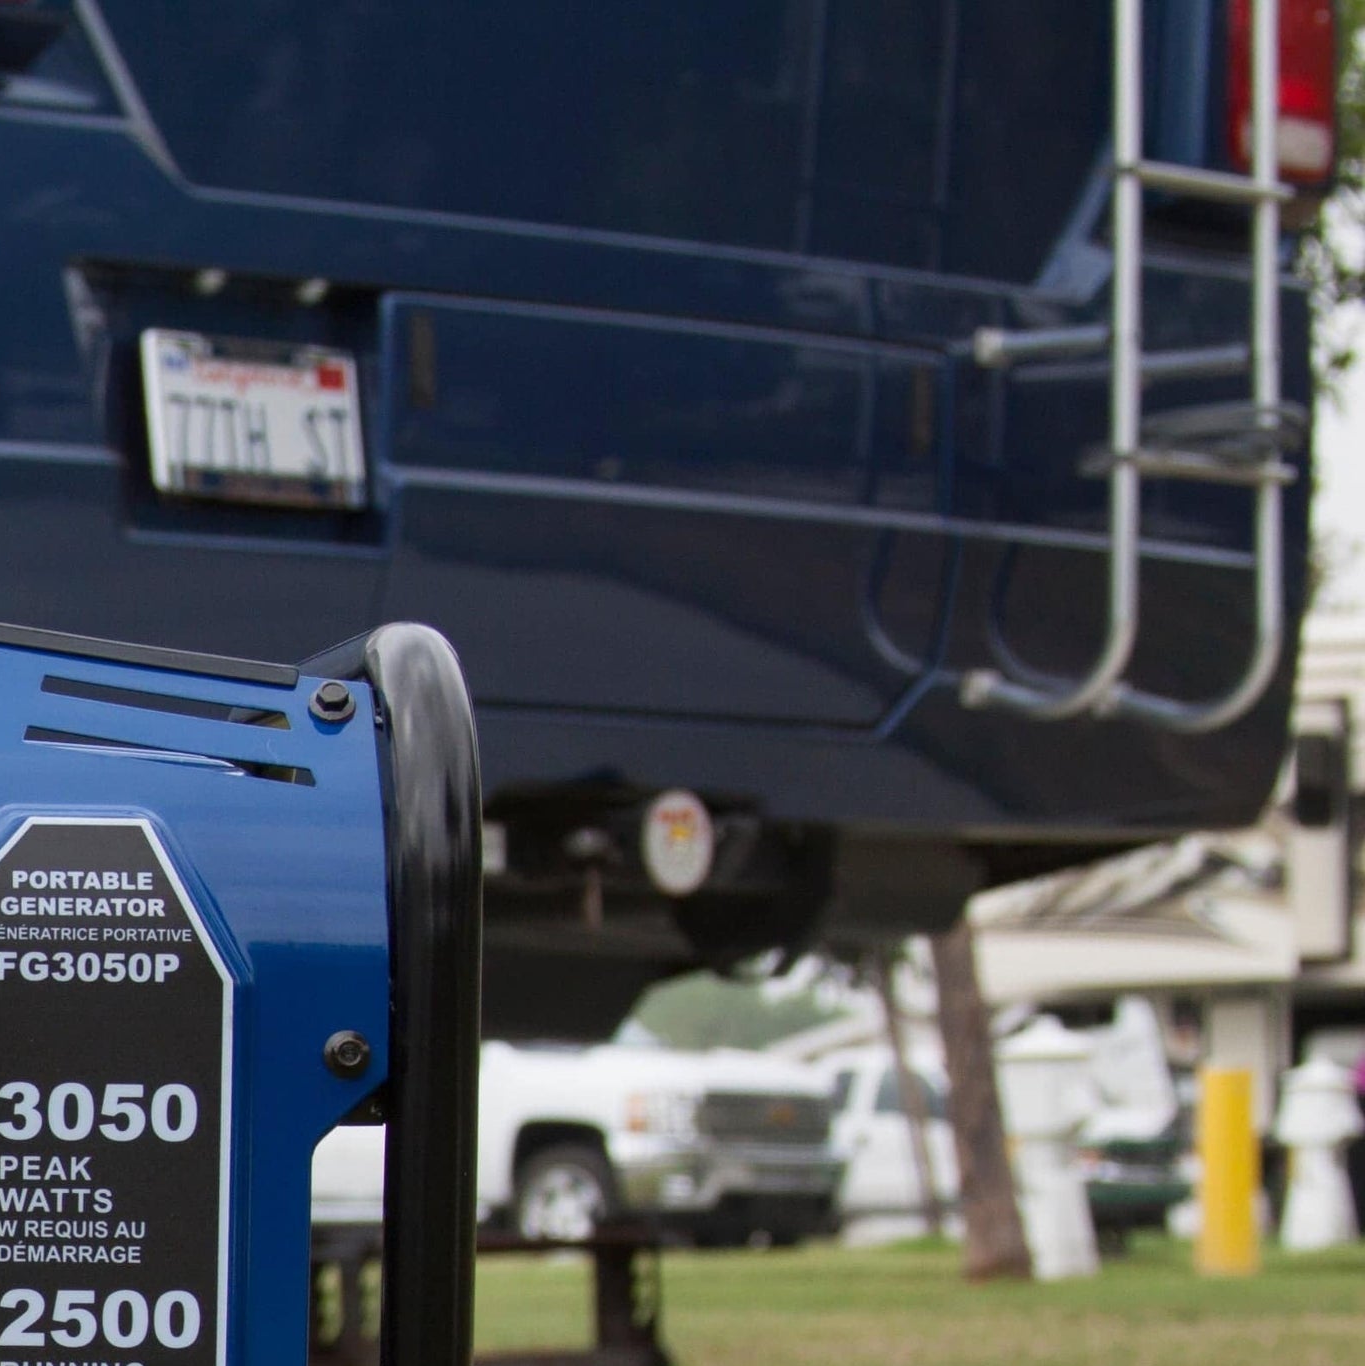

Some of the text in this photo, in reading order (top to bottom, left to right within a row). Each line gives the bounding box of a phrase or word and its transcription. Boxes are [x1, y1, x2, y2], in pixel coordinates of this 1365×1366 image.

[11, 870, 154, 890] PORTABLE
[0, 896, 166, 917] GENERATOR
[103, 928, 192, 942] PORTATIVE
[0, 1155, 92, 1181] PEAK
[24, 1220, 108, 1239] REQUIS
[114, 1221, 146, 1239] AU
